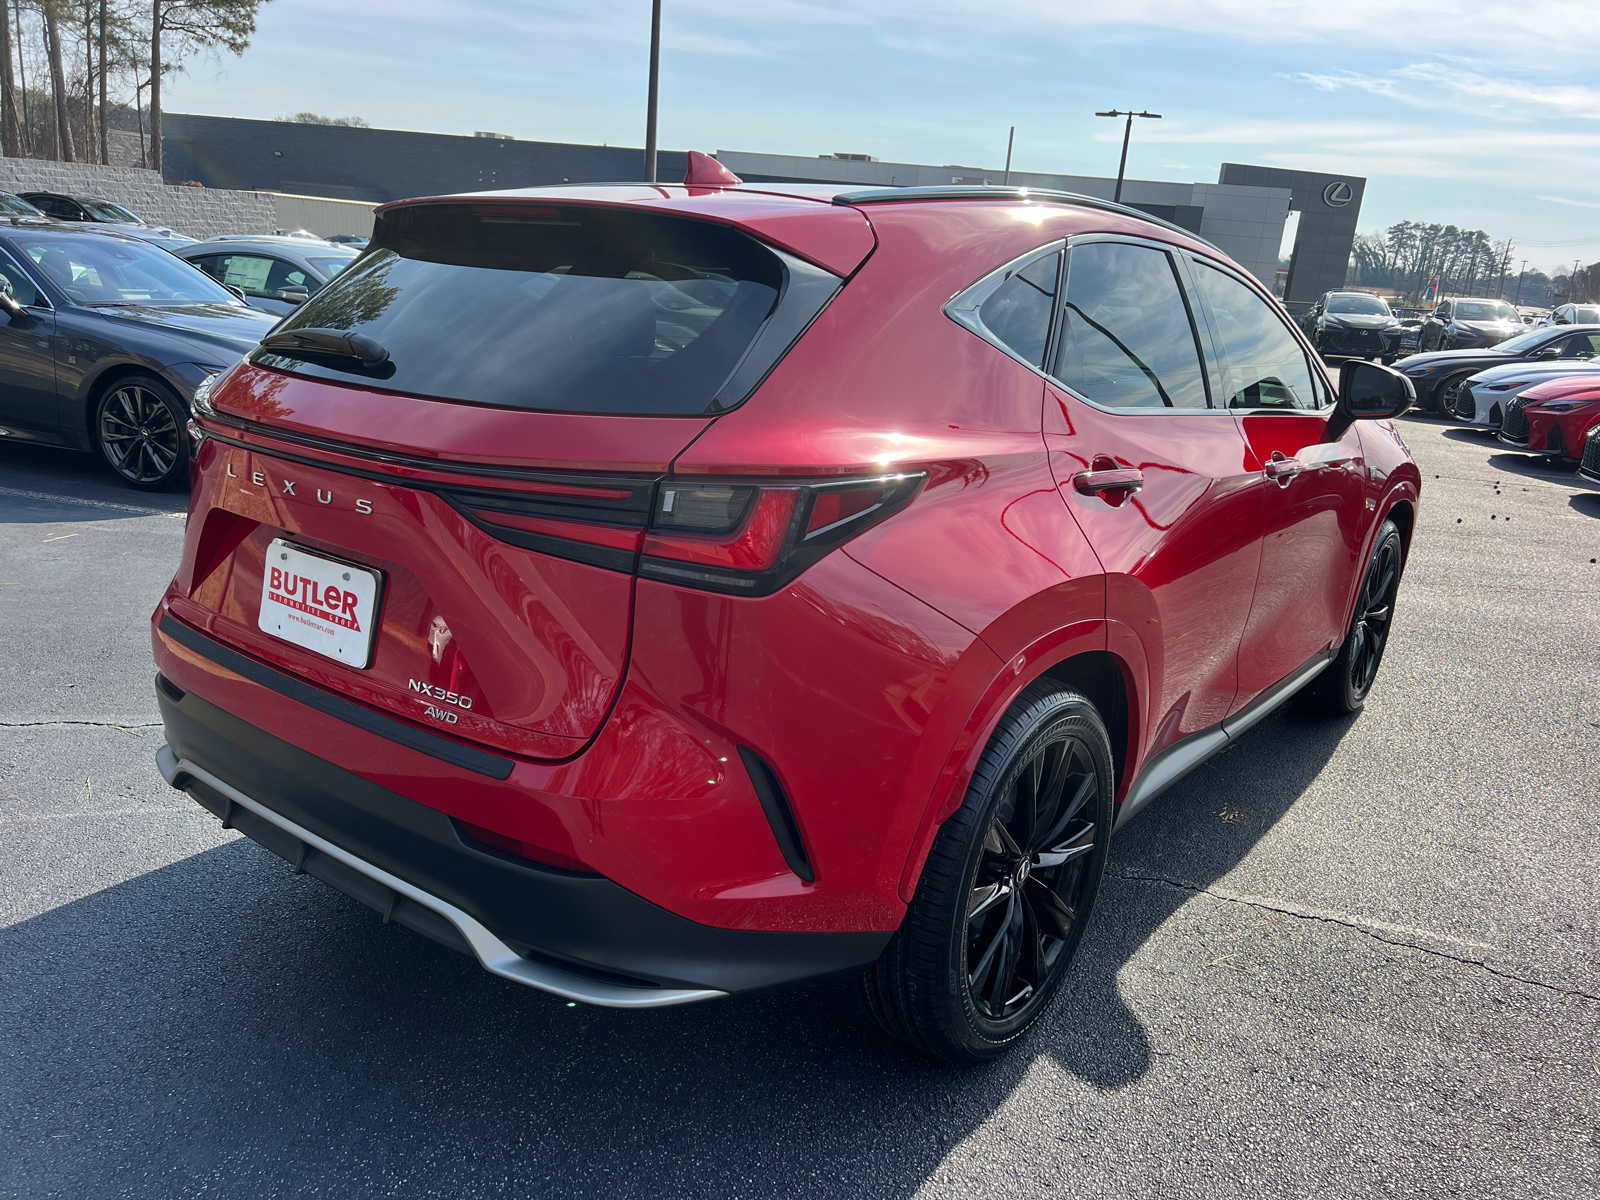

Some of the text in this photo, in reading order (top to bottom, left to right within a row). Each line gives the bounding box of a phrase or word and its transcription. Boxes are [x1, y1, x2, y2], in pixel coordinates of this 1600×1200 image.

[227, 463, 373, 515] LEXUS
[287, 613, 335, 636] www.butlercars.com
[329, 613, 359, 630] GROUP
[424, 706, 458, 724] AWD
